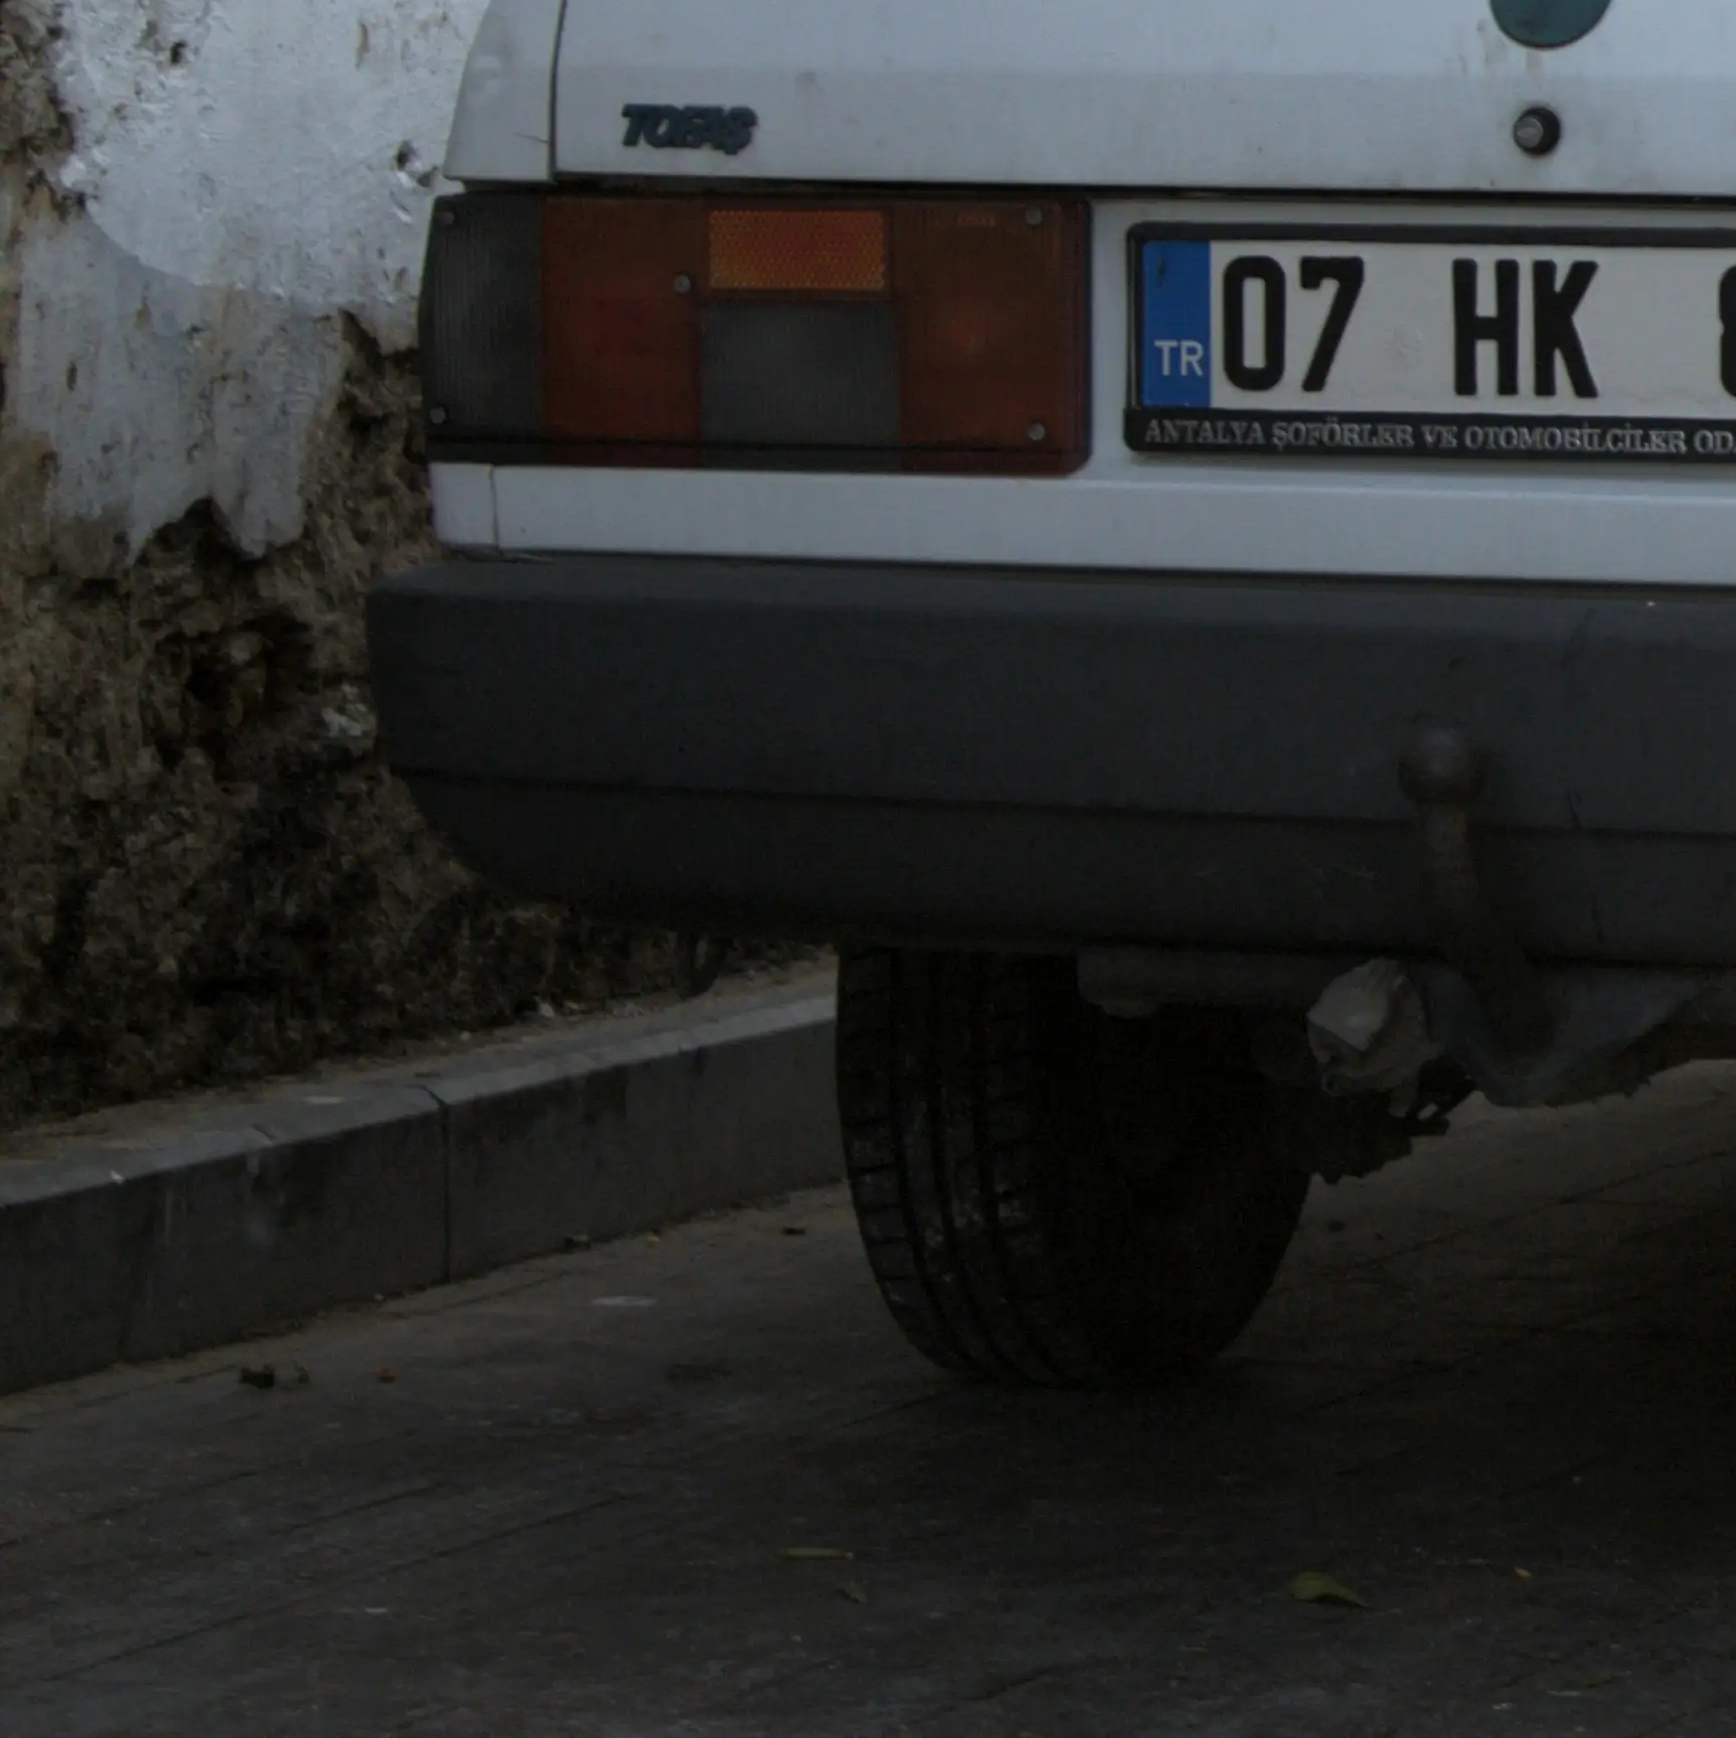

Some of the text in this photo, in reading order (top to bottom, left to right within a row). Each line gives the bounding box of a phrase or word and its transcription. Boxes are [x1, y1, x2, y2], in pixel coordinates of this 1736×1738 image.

[1155, 340, 1204, 377] TR
[1222, 255, 1365, 393] 07
[1452, 258, 1598, 398] HK
[1144, 419, 1265, 445] ANTALYA
[1272, 416, 1414, 451] ŞOFÖRLER
[1421, 425, 1458, 449] VE
[1464, 420, 1686, 455] OTOMOBİLCİLER
